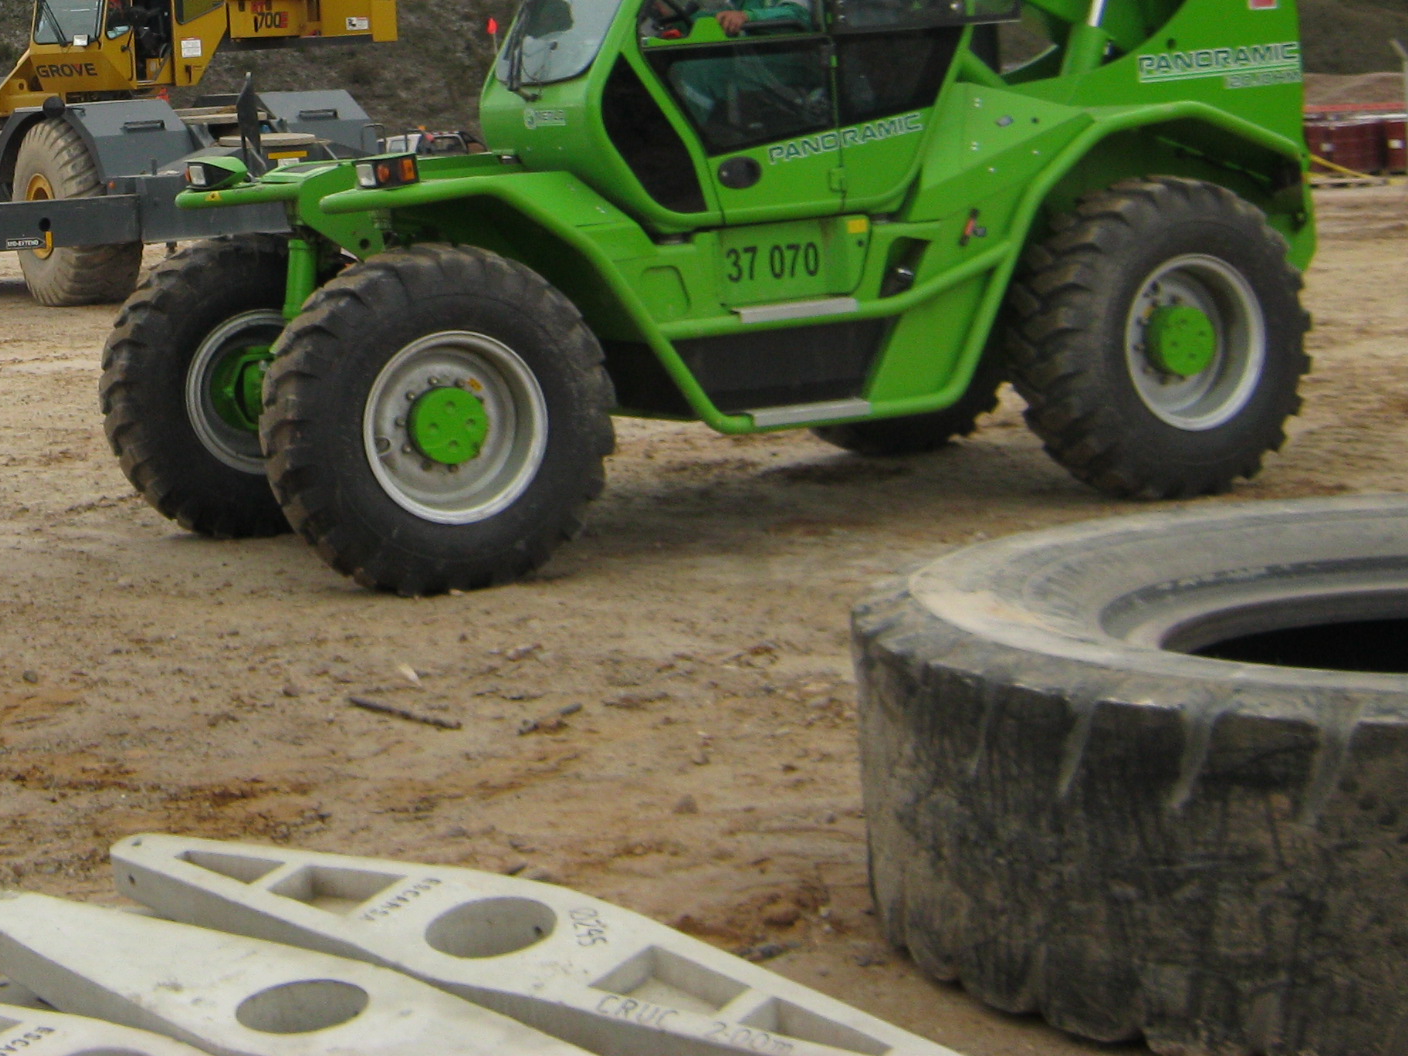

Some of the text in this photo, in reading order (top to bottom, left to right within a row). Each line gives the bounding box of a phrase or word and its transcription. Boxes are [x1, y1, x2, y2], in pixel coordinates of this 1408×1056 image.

[36, 63, 98, 78] GROVE
[1138, 41, 1301, 74] PANORAMIC
[768, 112, 924, 165] PANORAMIC
[726, 242, 819, 283] 37 070
